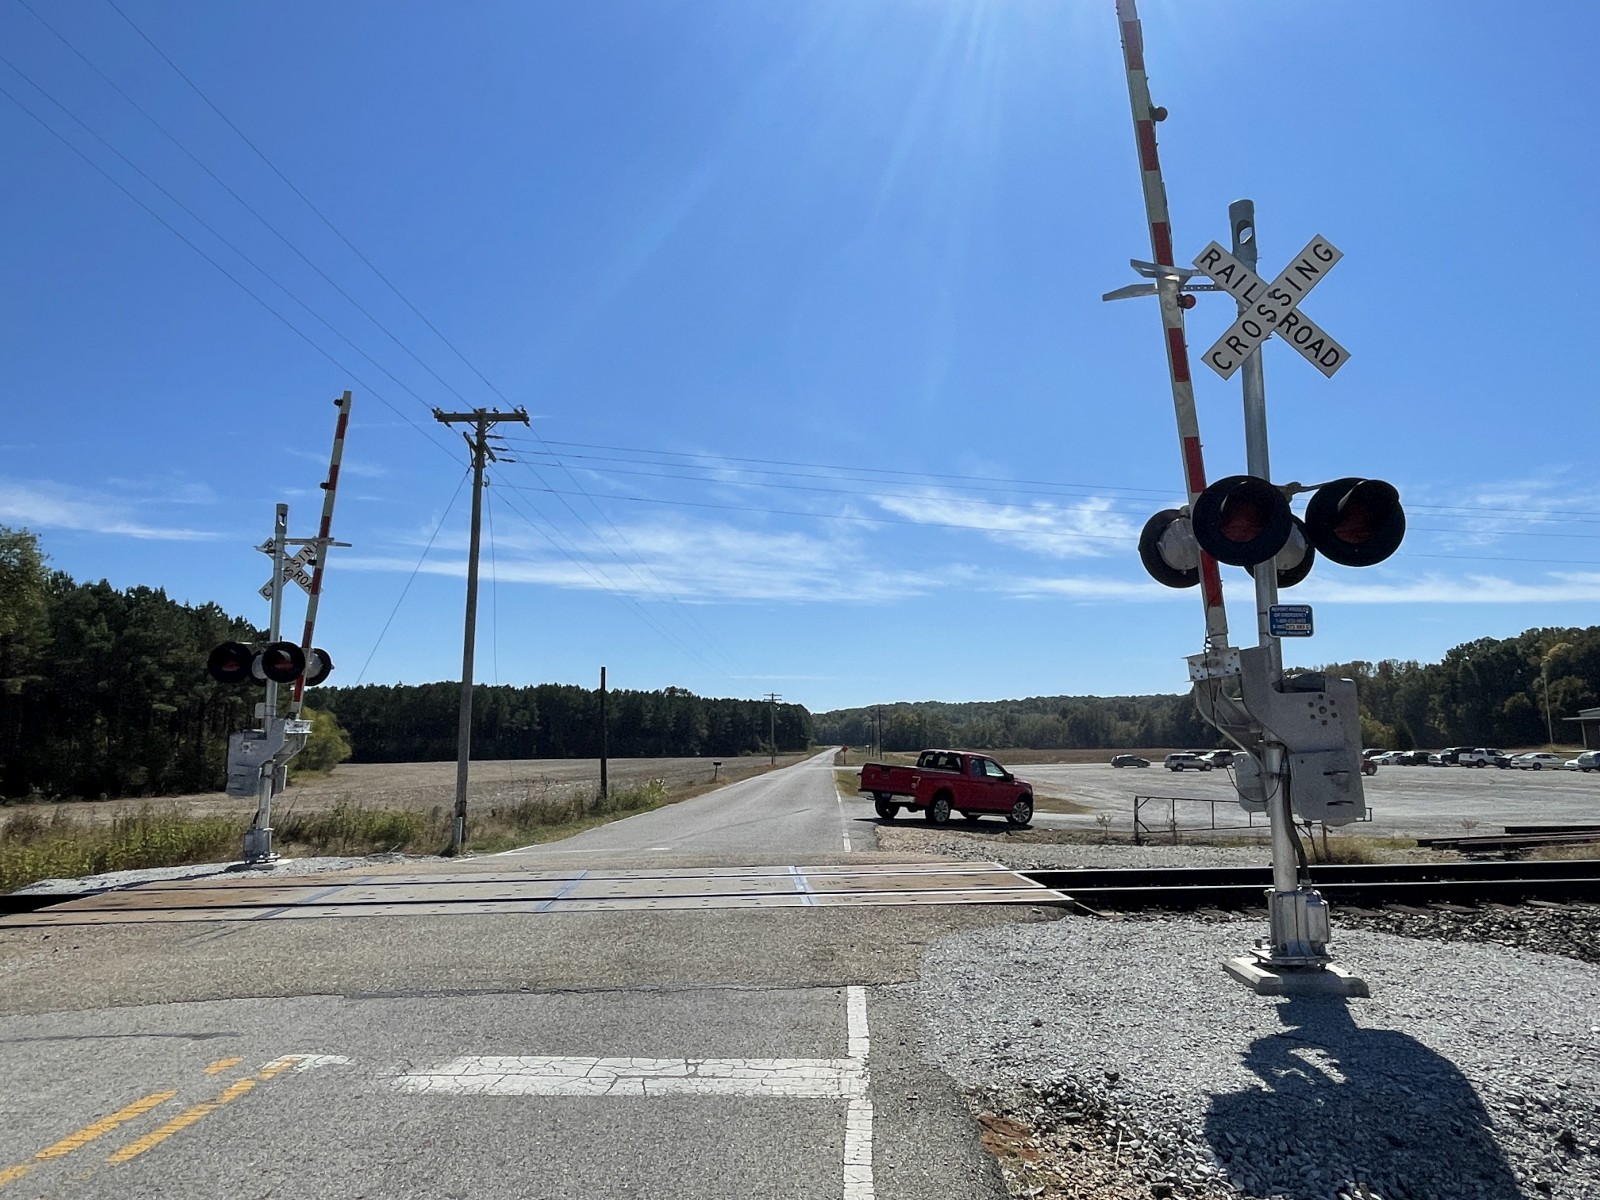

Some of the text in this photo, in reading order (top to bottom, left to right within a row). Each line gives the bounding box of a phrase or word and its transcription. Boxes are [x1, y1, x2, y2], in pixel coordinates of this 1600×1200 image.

[1200, 247, 1340, 368] RAIL ROAD
[1212, 243, 1333, 370] CROSSING
